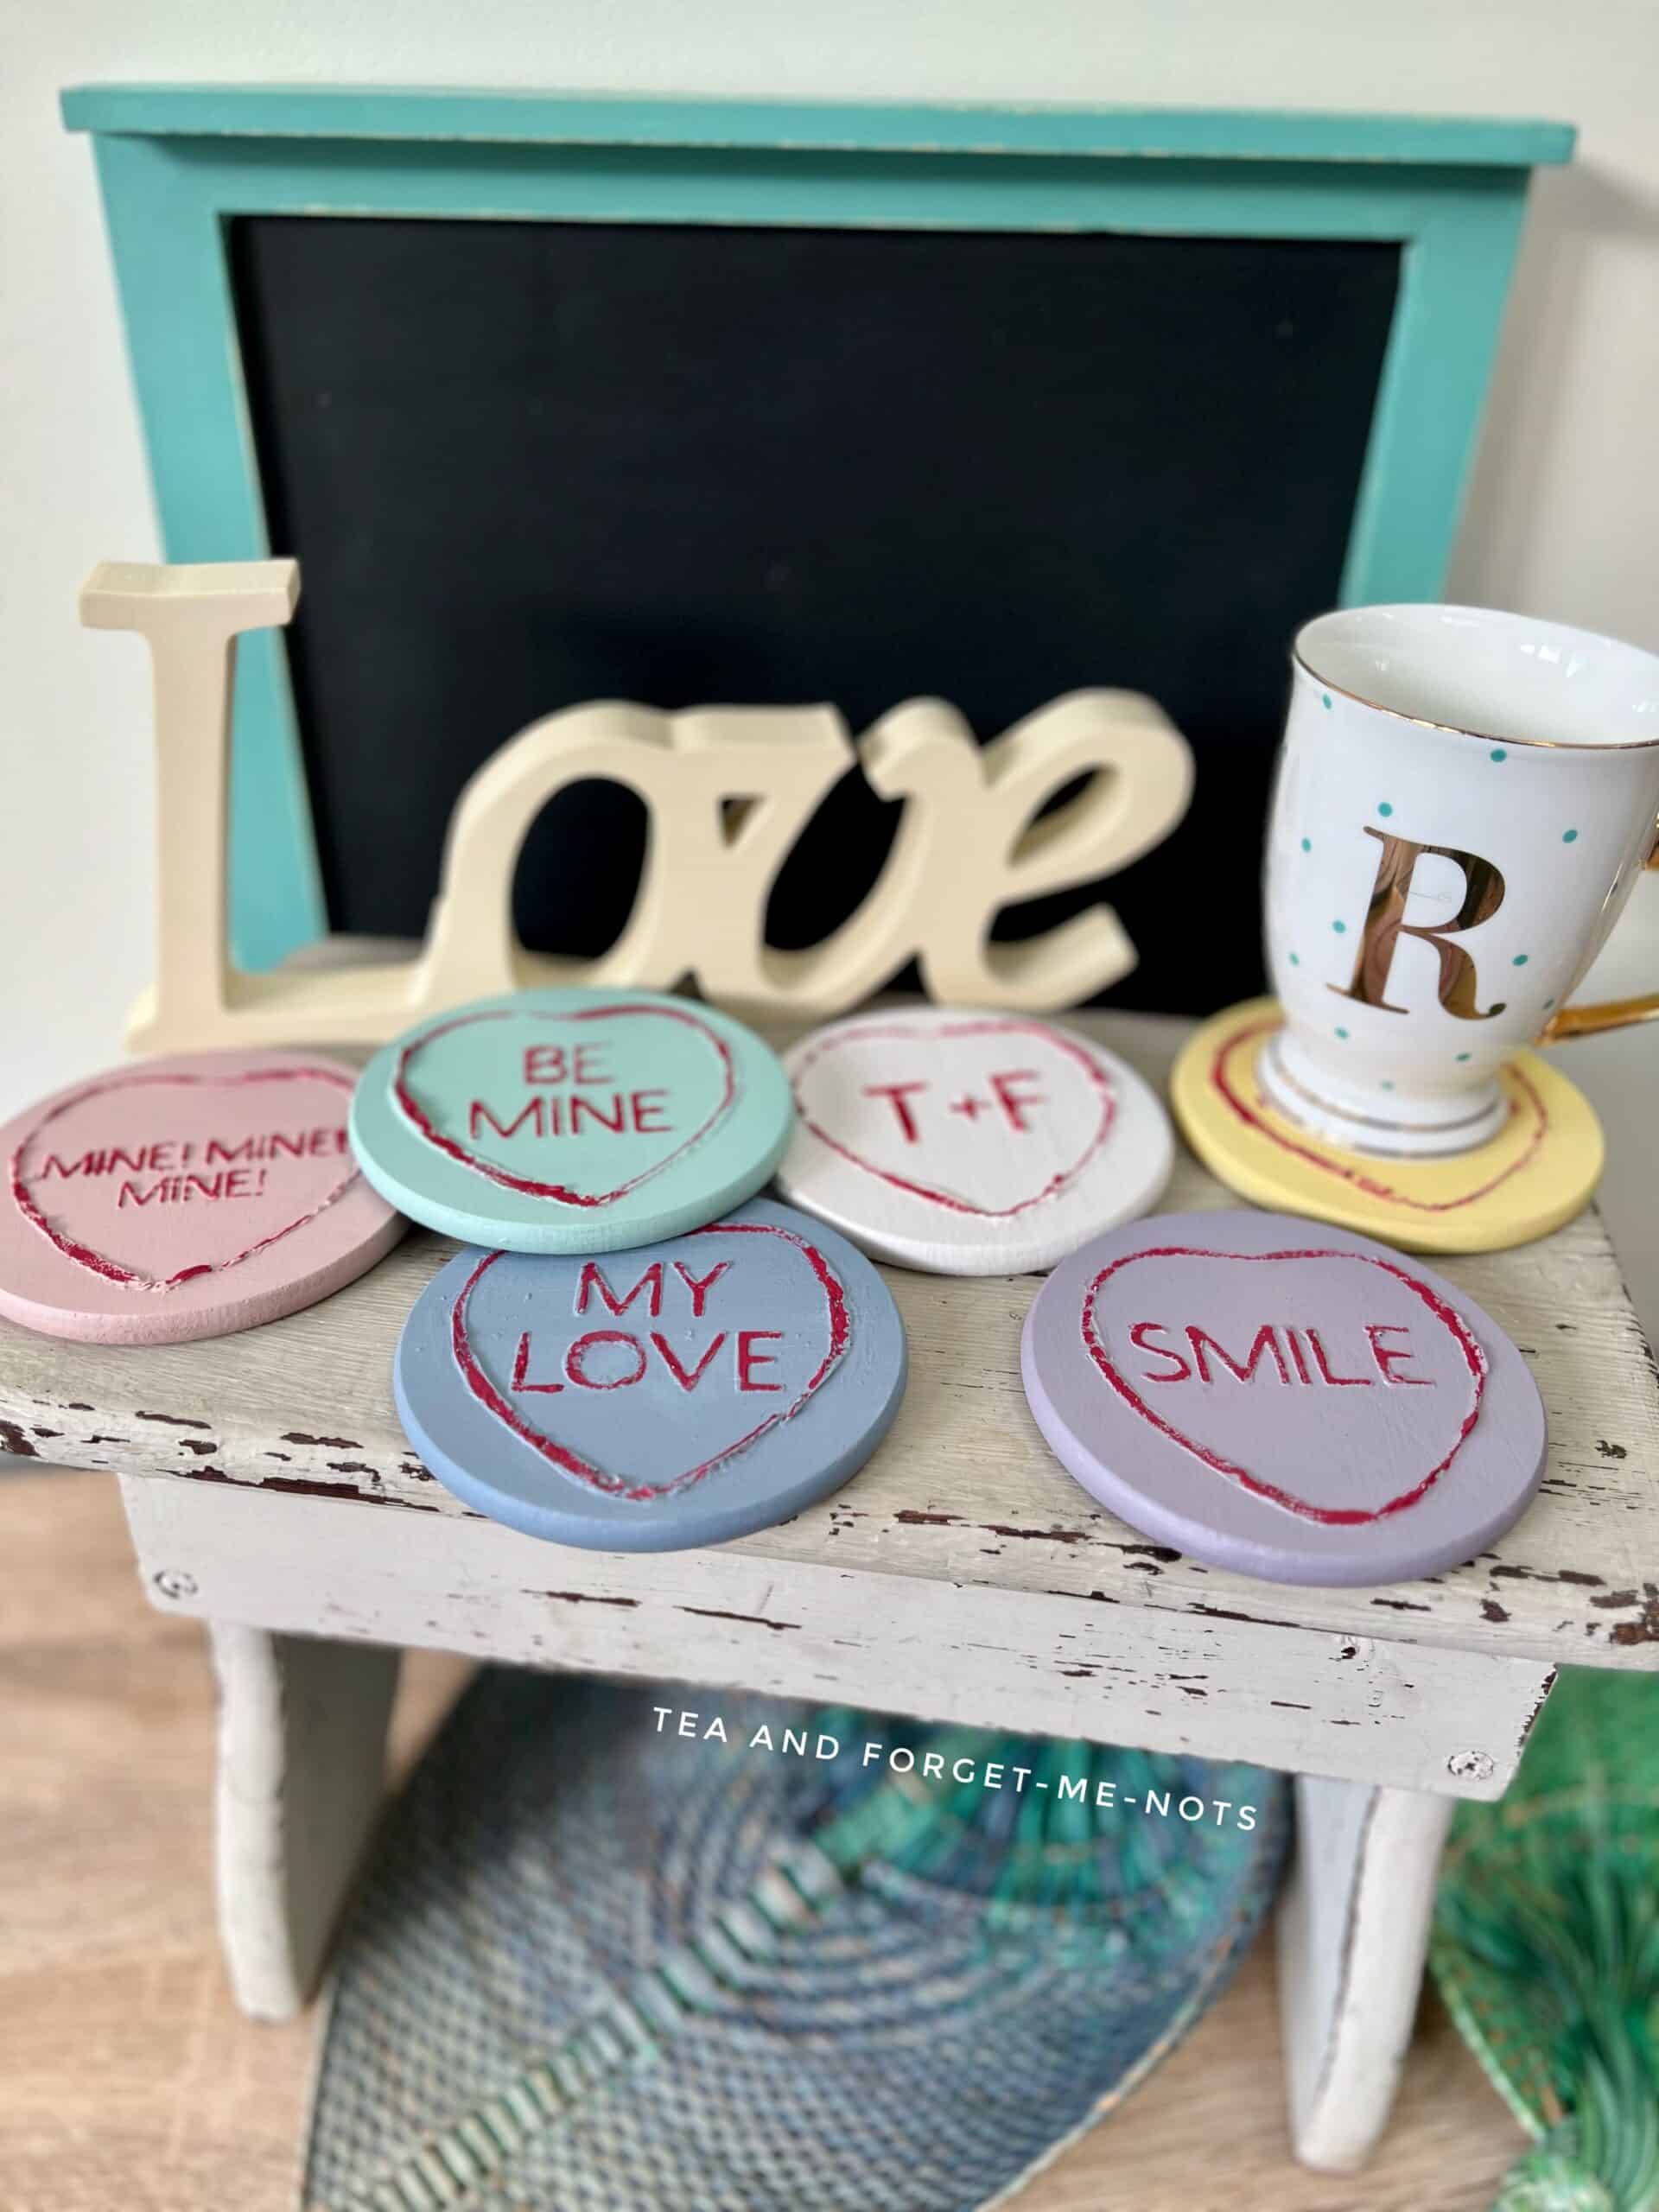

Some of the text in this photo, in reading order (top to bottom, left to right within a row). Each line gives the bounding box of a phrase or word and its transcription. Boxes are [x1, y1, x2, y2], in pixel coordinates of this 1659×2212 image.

[78, 560, 1196, 1054] Love
[1326, 825, 1506, 1020] R
[523, 1042, 616, 1086] BE
[468, 1090, 674, 1139] MINE
[41, 1142, 190, 1180] MINE!
[117, 1169, 269, 1208] MINE!
[575, 1262, 734, 1317] MY
[512, 1330, 784, 1395] LOVE
[1128, 1323, 1436, 1387] SMILE
